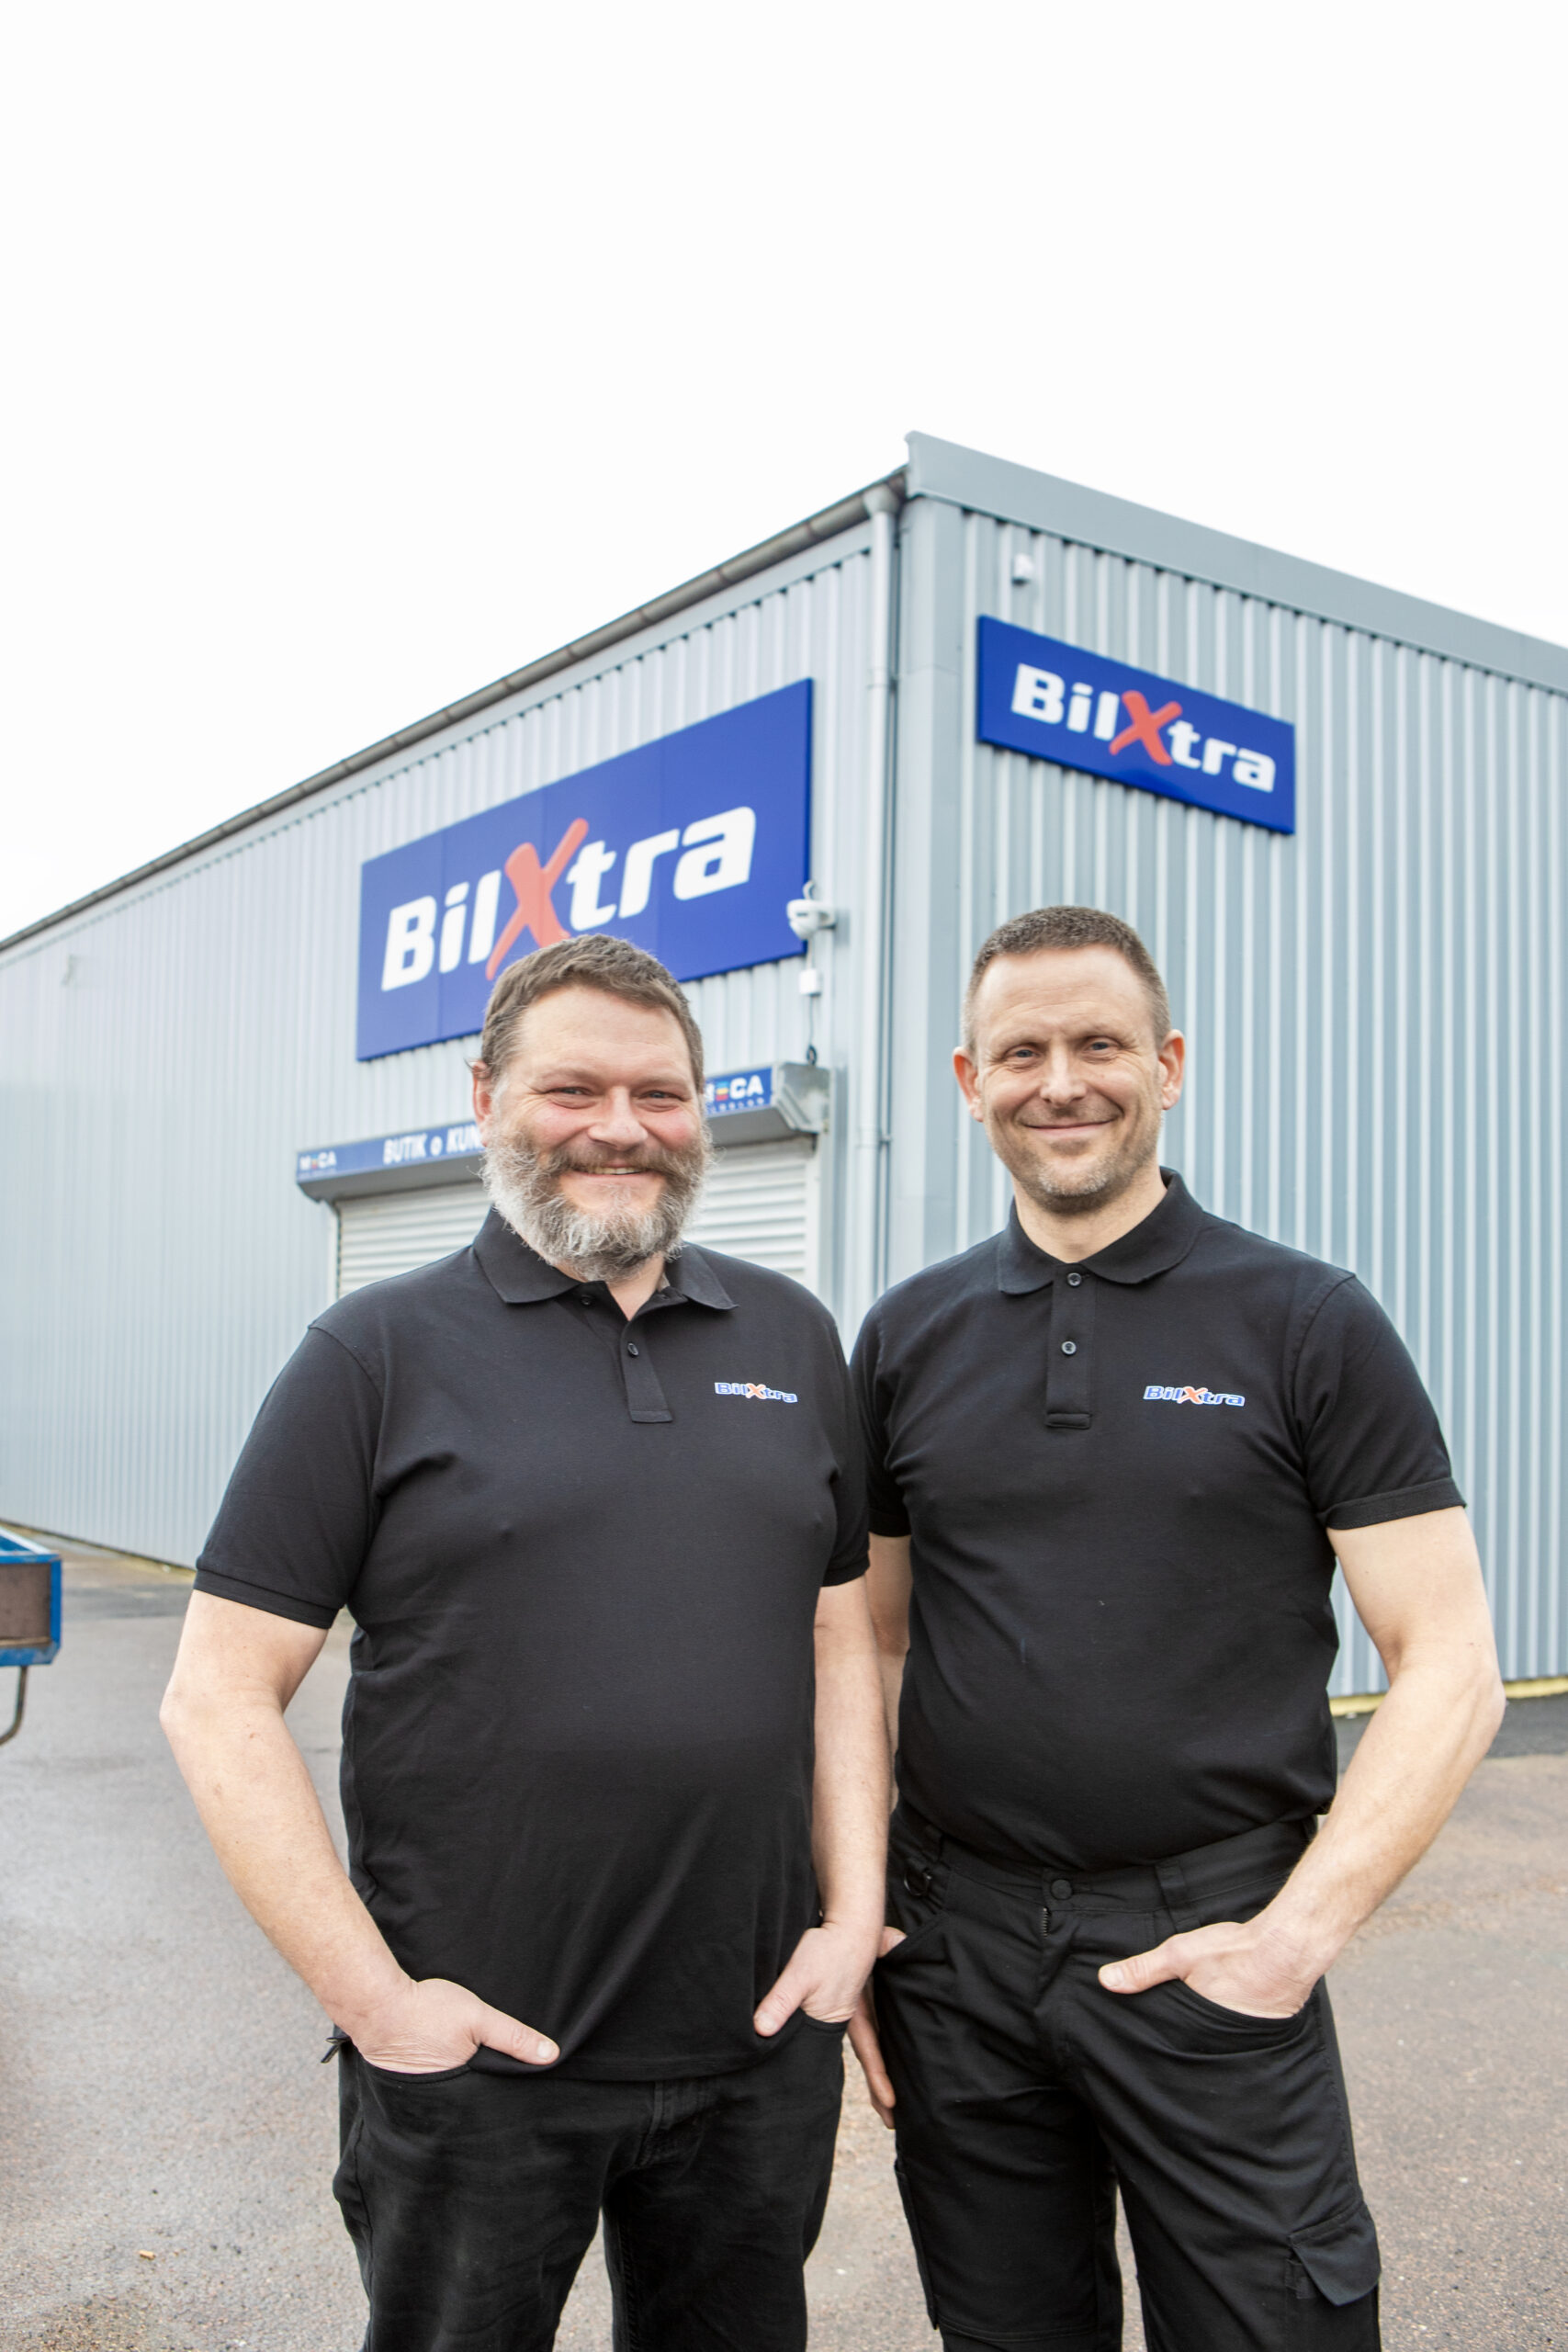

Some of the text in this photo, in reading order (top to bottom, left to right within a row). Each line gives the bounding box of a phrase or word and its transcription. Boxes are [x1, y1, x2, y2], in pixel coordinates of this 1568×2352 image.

[1010, 662, 1276, 794] BilXtra
[381, 806, 756, 992] BilXtra
[383, 1134, 426, 1165] BUTIK
[714, 1382, 798, 1403] BilXtra
[1143, 1385, 1246, 1407] BilXtra
